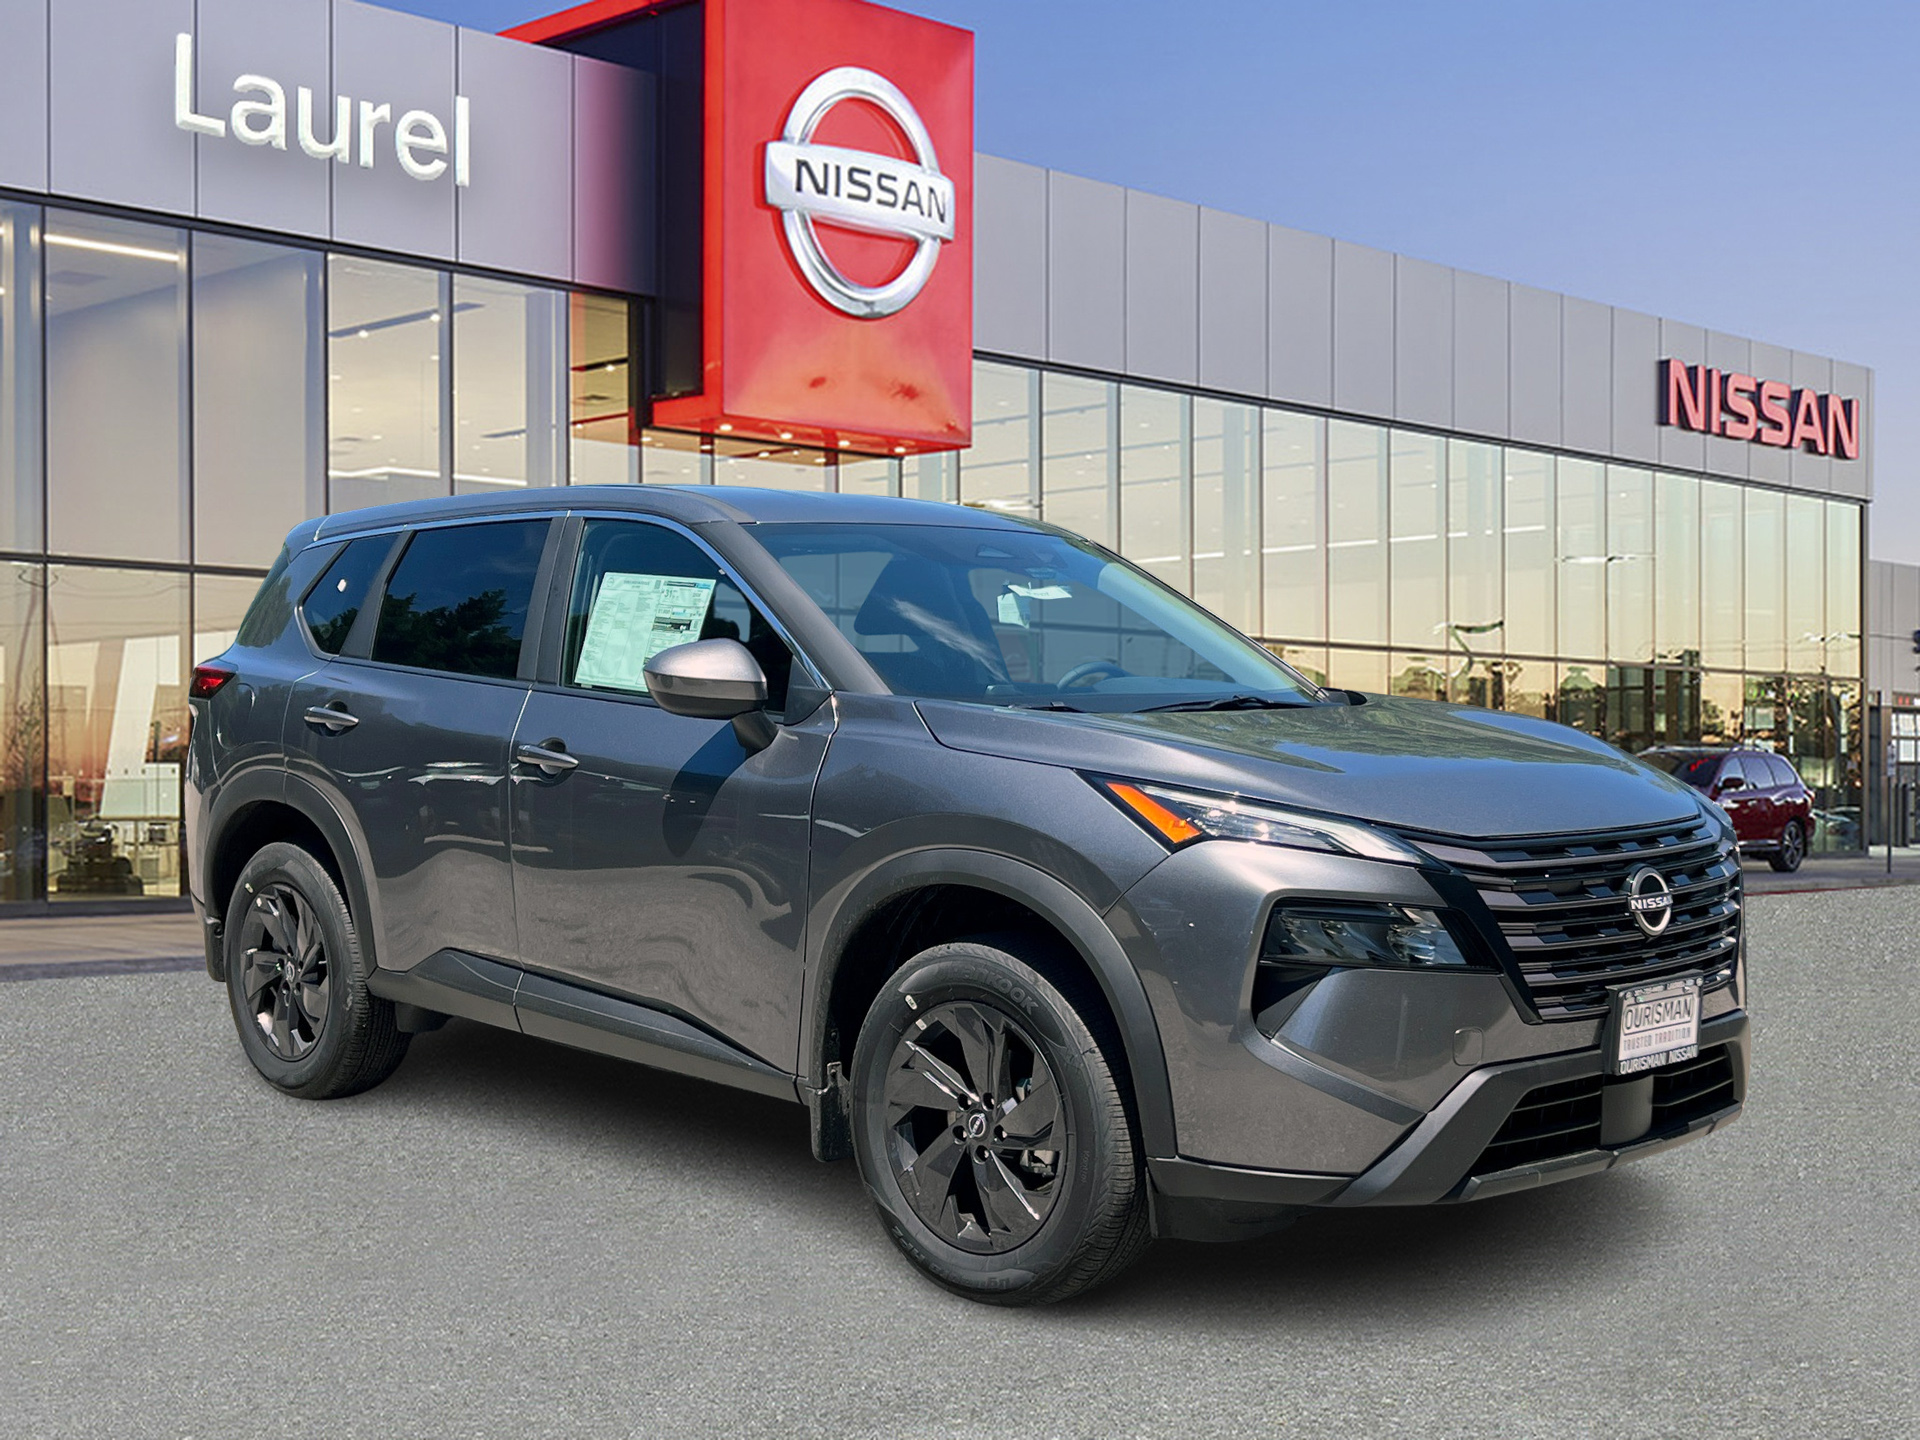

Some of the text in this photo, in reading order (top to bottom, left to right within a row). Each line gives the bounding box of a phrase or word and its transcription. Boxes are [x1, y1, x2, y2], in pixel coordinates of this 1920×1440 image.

[175, 32, 470, 188] Laurel
[795, 158, 946, 224] NISSAN
[1658, 358, 1859, 460] NISSAN
[1623, 1026, 1691, 1052] TRUSTED TRADITION
[1624, 998, 1692, 1031] OURISMAN
[1620, 1044, 1698, 1075] OURISMAN NISSAN
